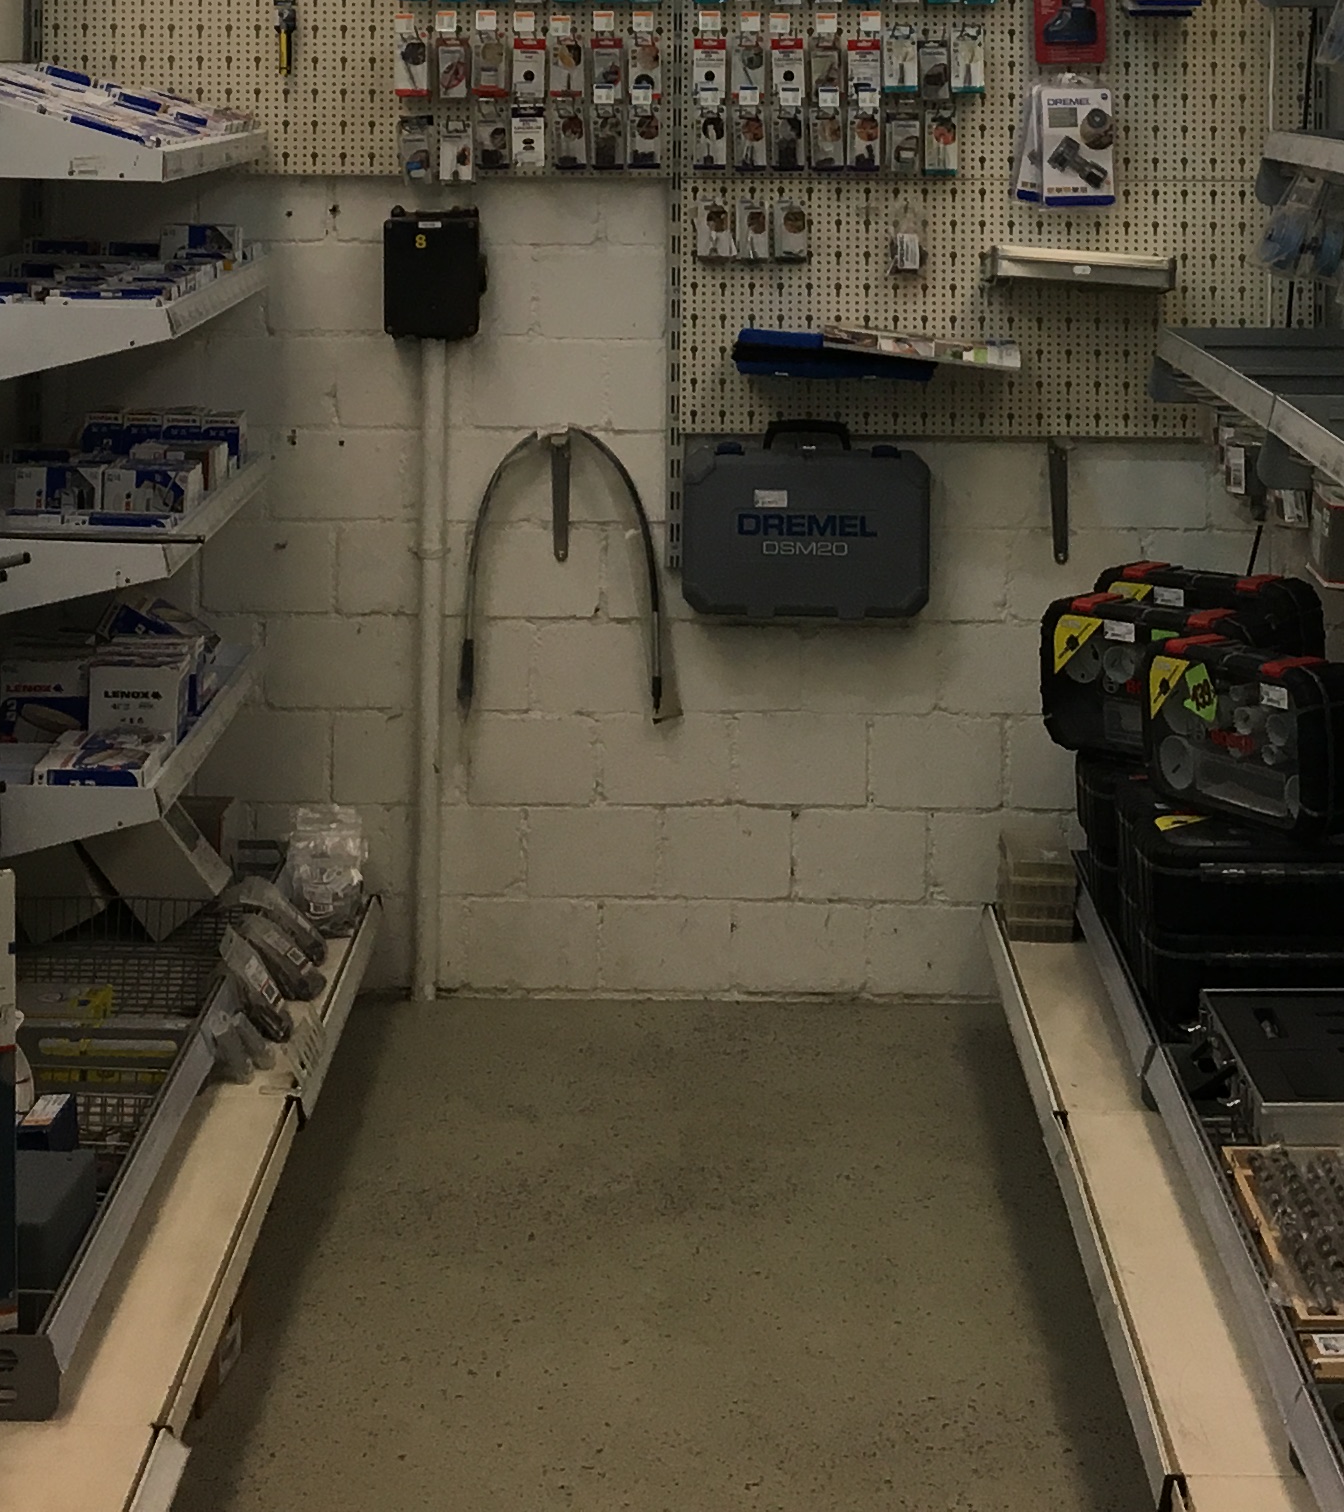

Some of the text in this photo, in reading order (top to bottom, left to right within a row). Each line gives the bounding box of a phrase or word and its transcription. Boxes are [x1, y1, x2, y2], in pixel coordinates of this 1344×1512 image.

[1046, 97, 1091, 106] DREMEL
[737, 513, 877, 537] DREMEL
[762, 540, 848, 556] DSM20
[6, 684, 51, 693] LENOX
[104, 690, 149, 699] LENOX
